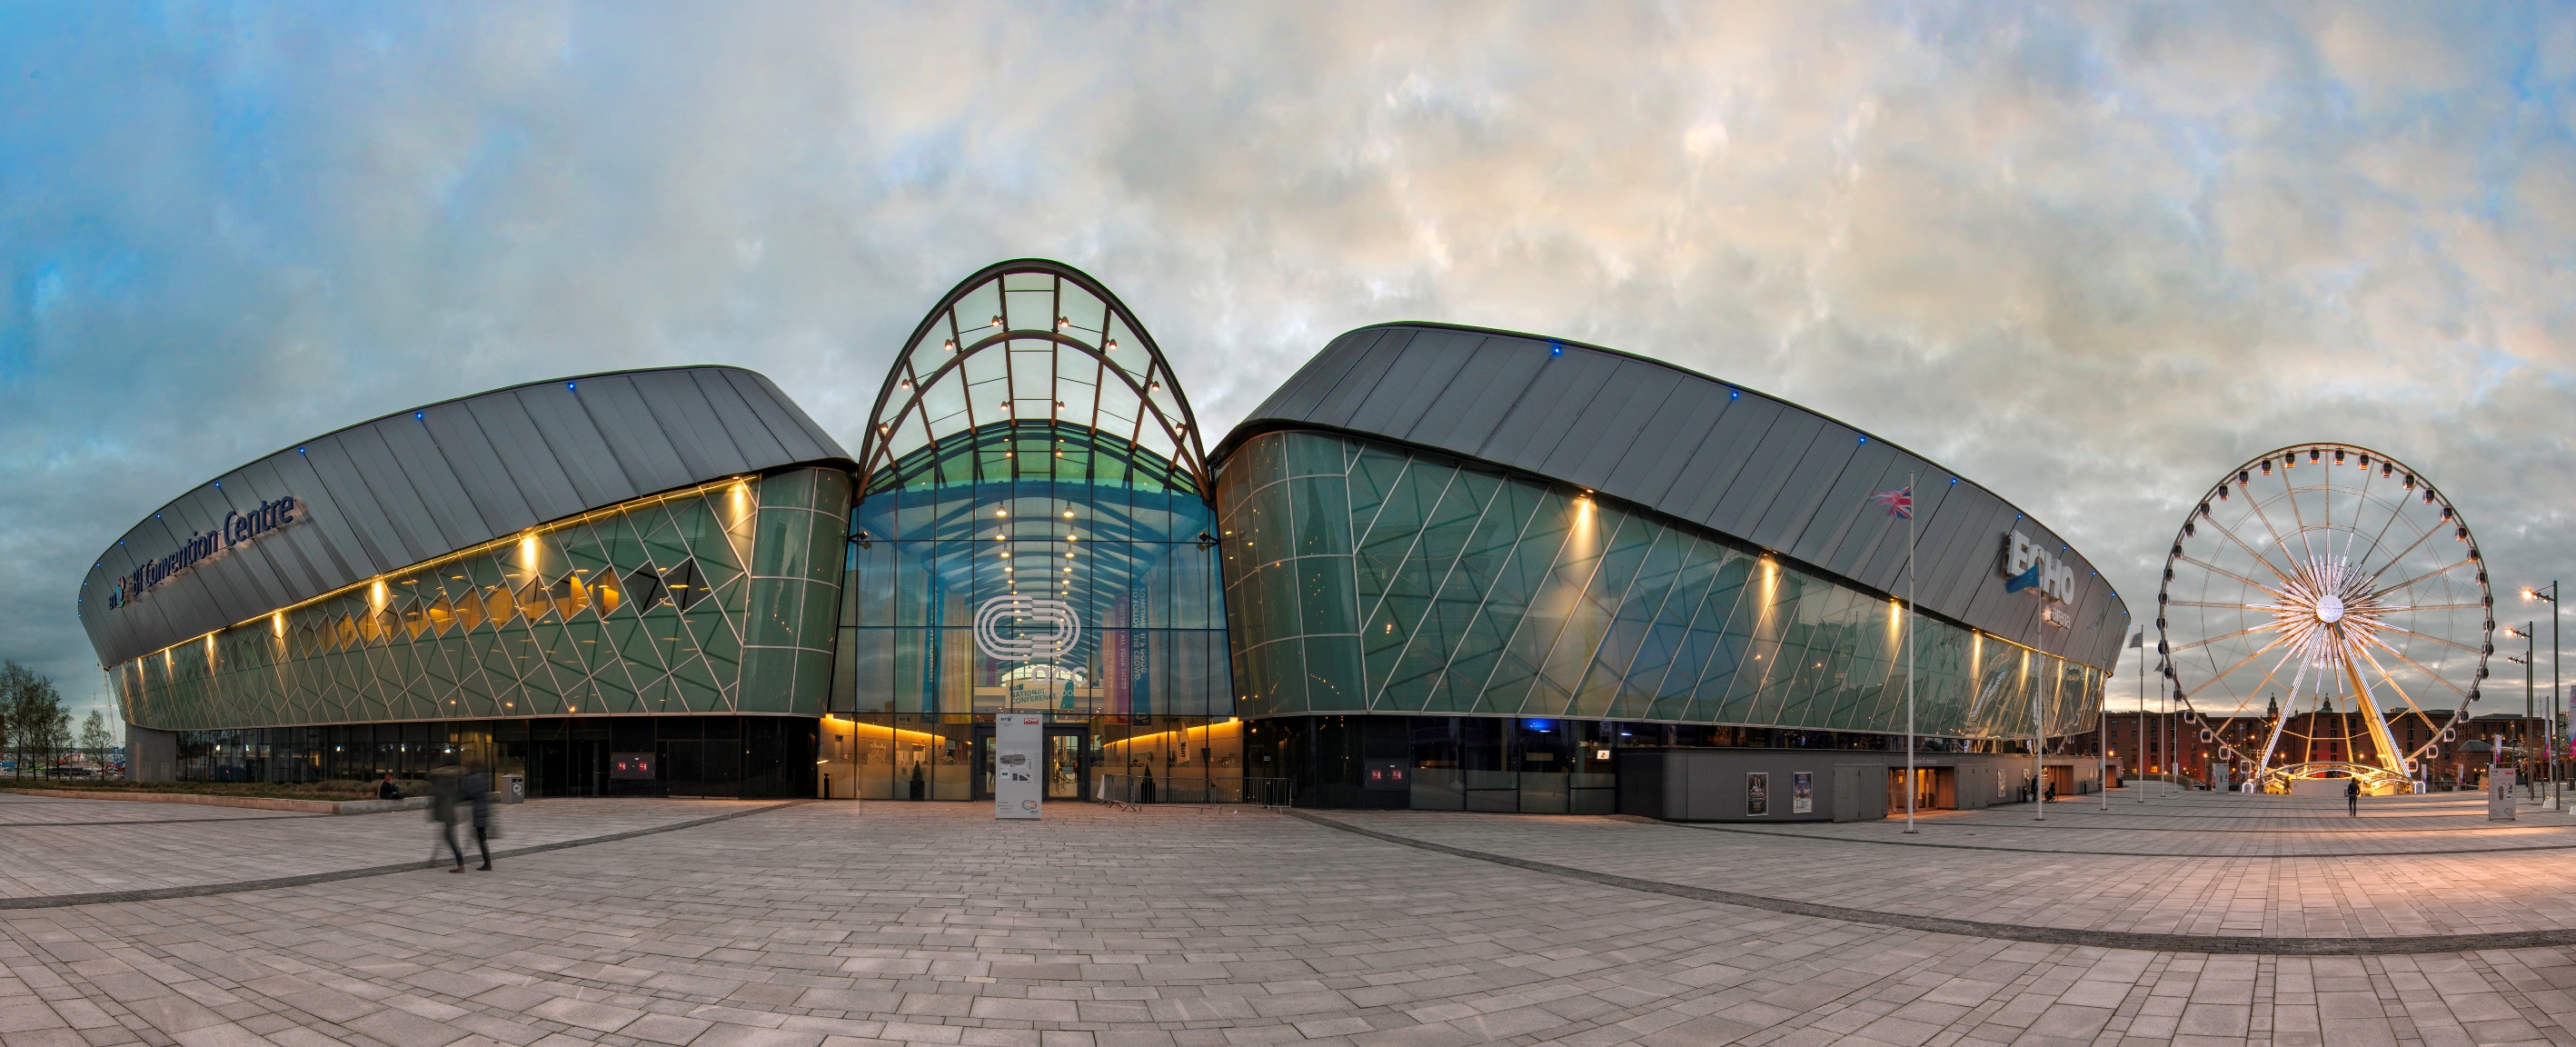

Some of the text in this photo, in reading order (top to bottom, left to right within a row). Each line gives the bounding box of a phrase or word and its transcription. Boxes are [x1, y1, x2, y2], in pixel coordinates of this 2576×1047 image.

[133, 495, 294, 596] BT Convention Centre
[2007, 530, 2075, 605] ECHO
[1132, 588, 1139, 599] TO
[2051, 606, 2071, 630] arena
[1031, 666, 1089, 685] acc
[1010, 689, 1046, 698] NATIONAL
